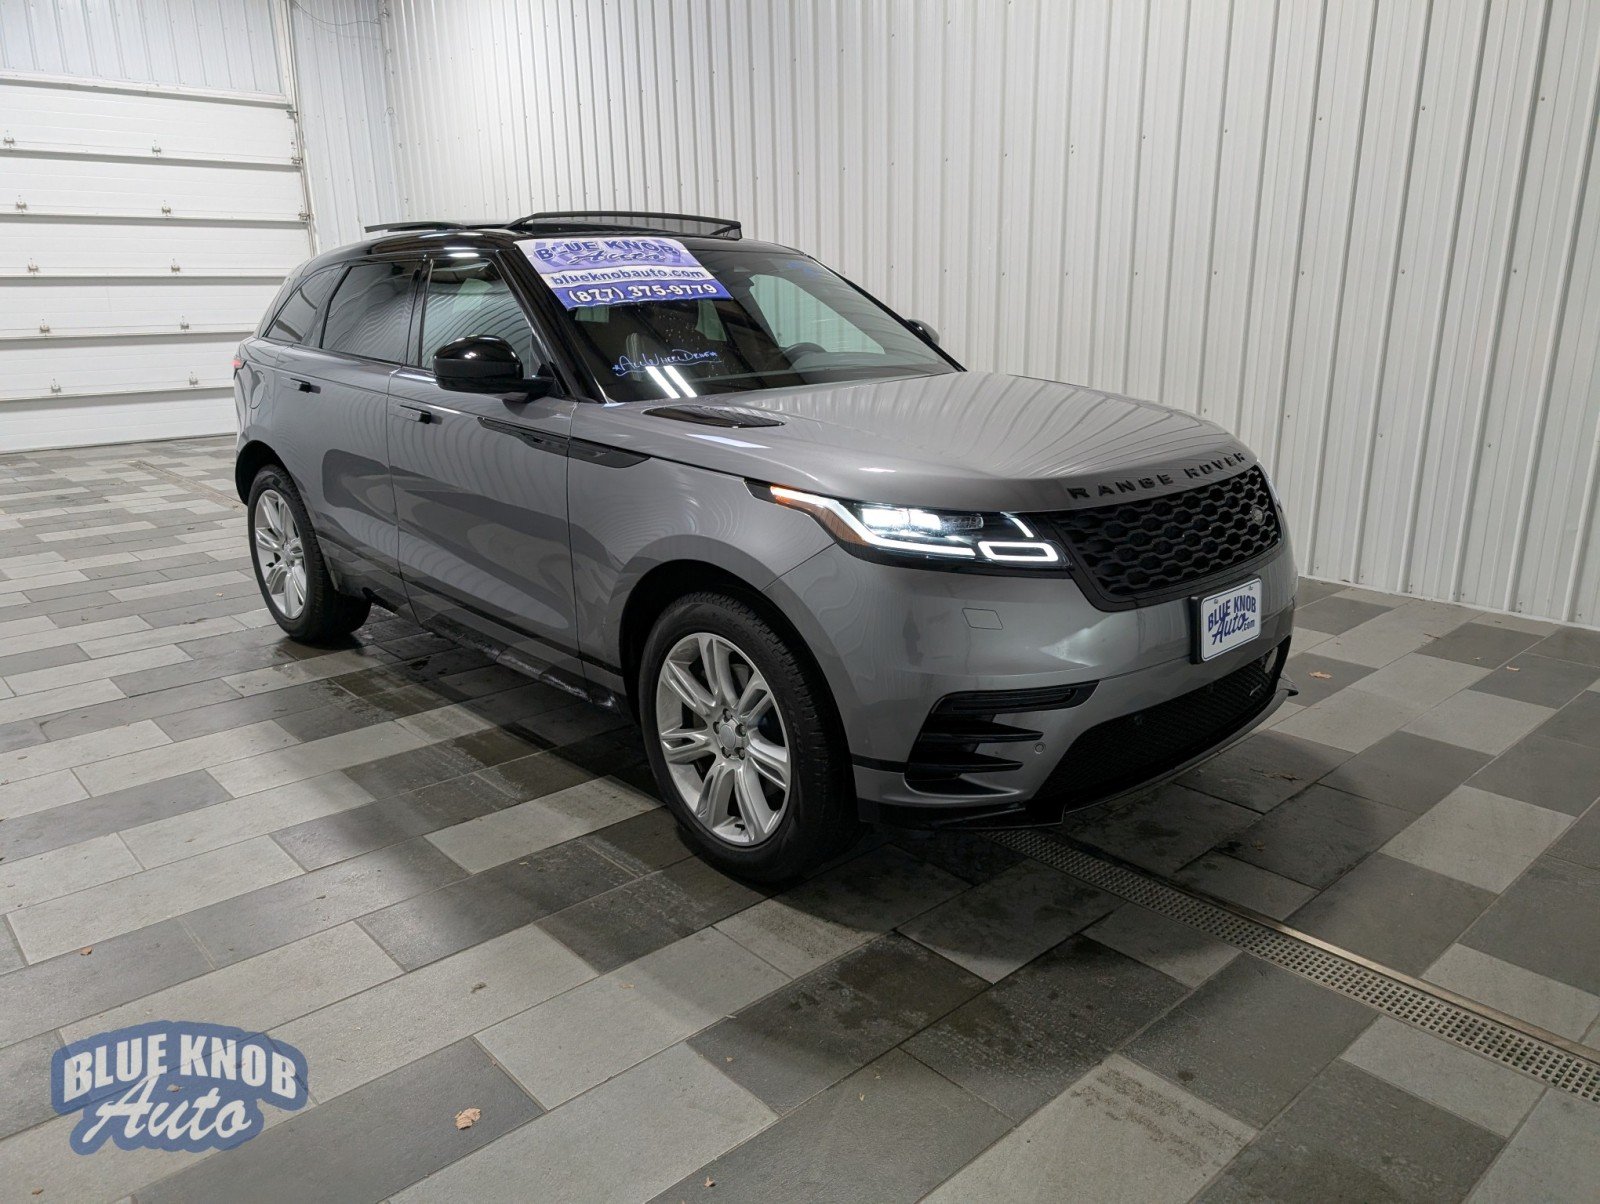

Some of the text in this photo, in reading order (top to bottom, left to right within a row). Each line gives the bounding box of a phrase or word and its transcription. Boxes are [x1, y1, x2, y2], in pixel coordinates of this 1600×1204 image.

[535, 241, 599, 261] BLUE
[551, 268, 705, 285] blueknobauto.com
[568, 284, 718, 303] (877) 375-9779
[1067, 452, 1246, 499] RANGE ROVER
[1208, 595, 1257, 633] BLUE KNOB
[1211, 612, 1249, 645] Auto
